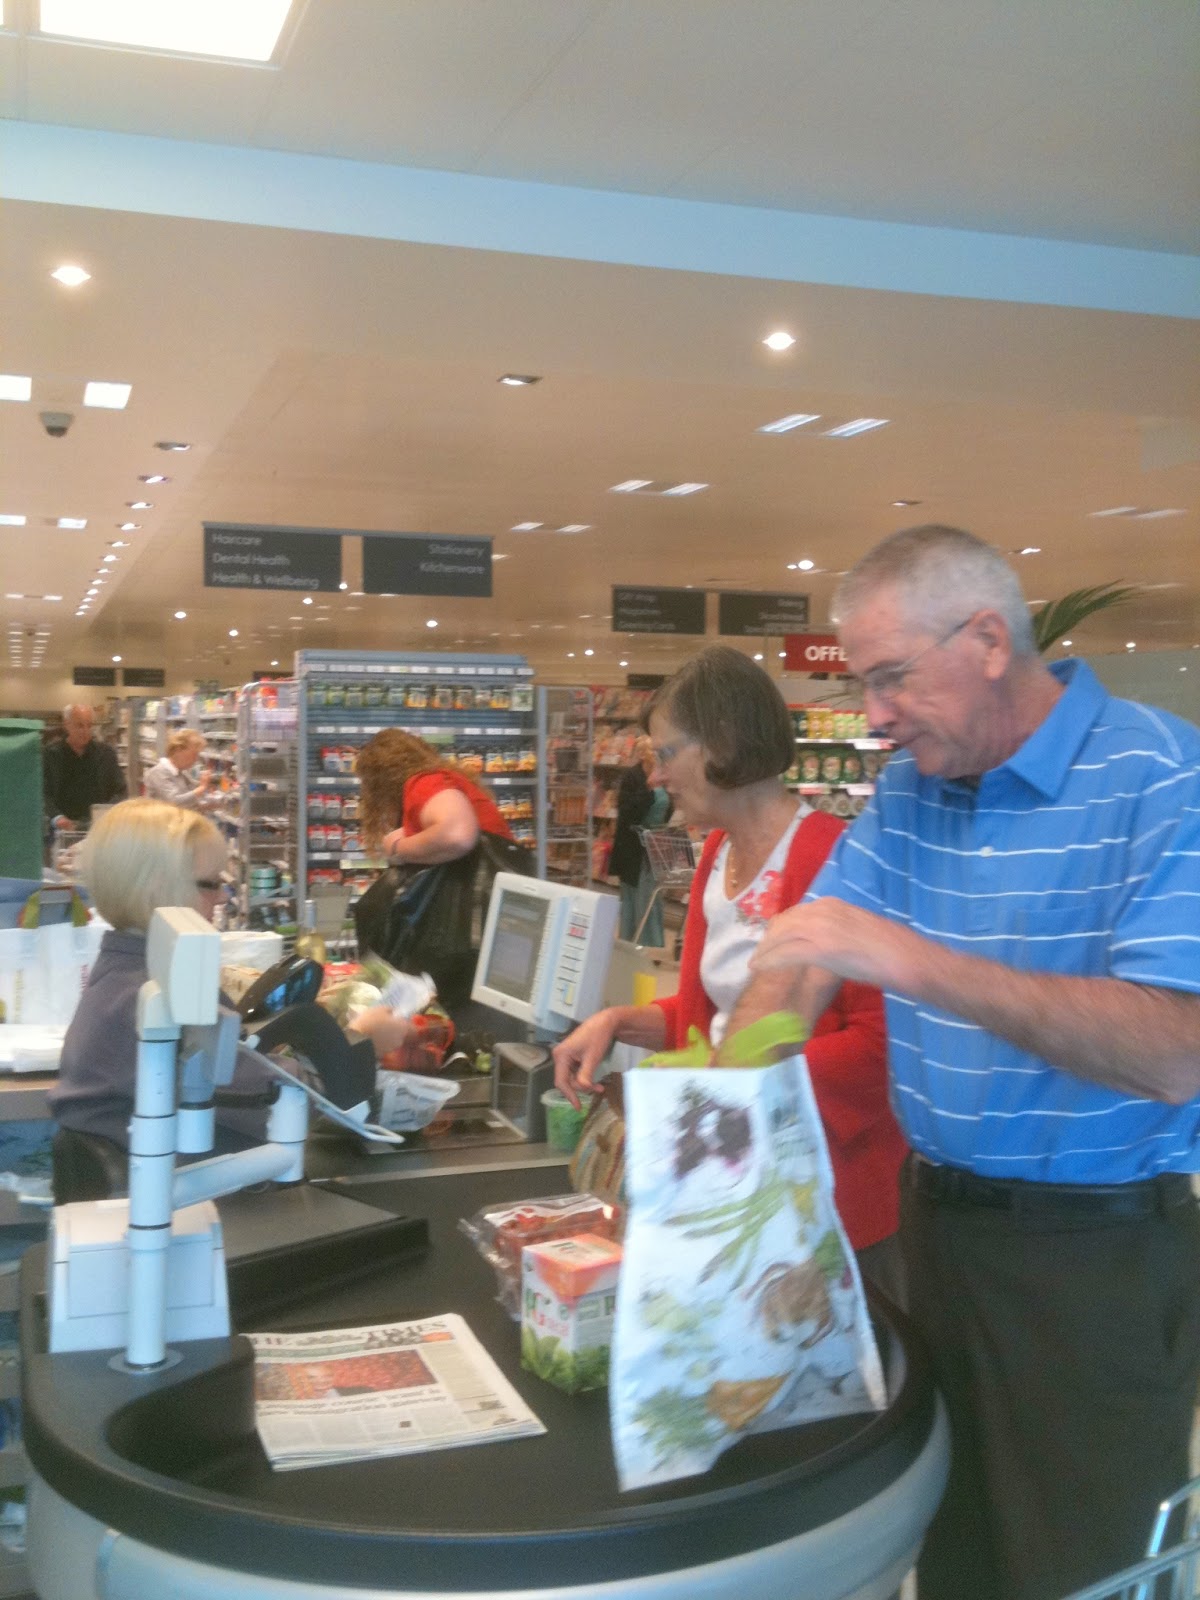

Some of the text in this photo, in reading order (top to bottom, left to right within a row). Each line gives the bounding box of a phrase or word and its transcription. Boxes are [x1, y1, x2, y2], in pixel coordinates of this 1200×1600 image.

[212, 533, 261, 546] Haircare
[428, 543, 485, 559] Stationery
[213, 552, 291, 566] Dental Health
[420, 561, 485, 575] Kitchenware
[212, 572, 319, 590] Health & Wellbeing
